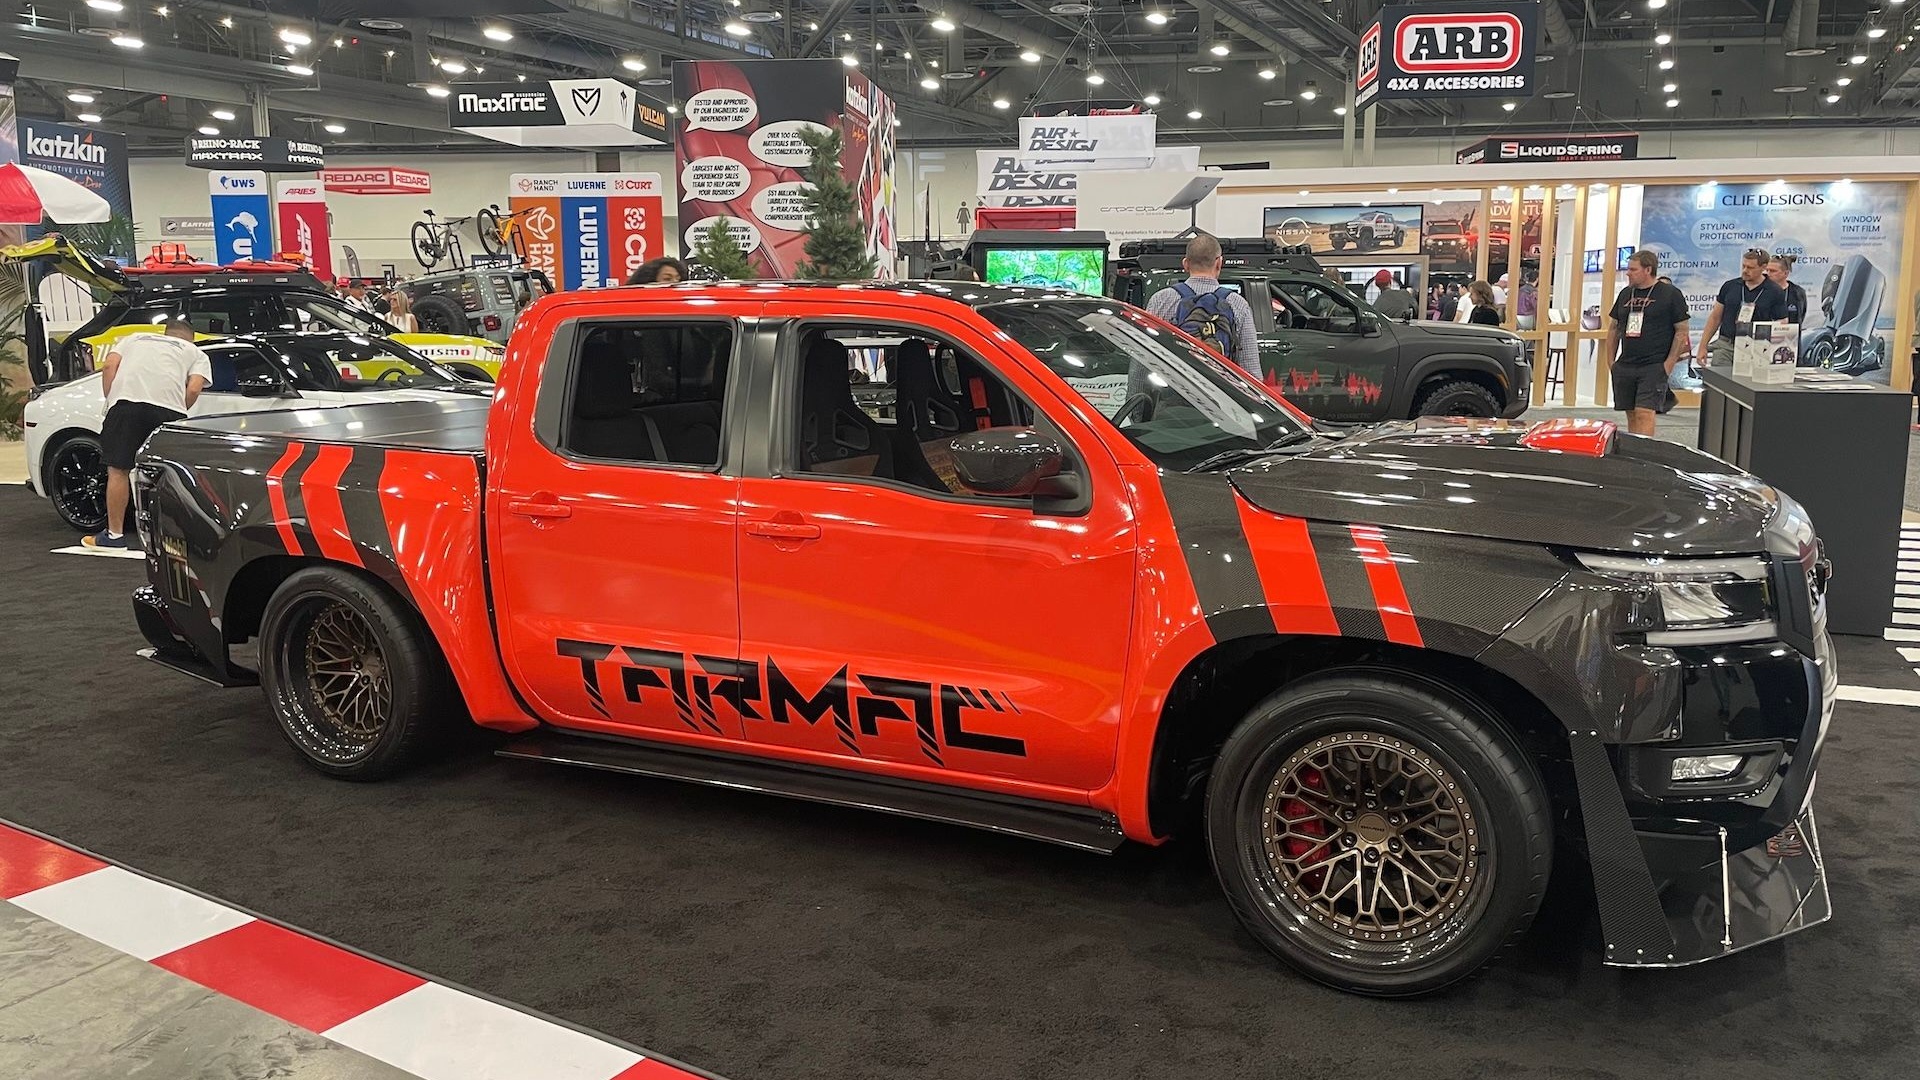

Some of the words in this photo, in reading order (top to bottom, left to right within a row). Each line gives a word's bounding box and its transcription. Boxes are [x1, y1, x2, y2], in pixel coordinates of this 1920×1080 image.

[1409, 26, 1508, 61] ARB
[1361, 35, 1378, 78] ARB
[1386, 78, 1420, 91] 4X4
[1423, 76, 1525, 90] ACCESSORIES
[458, 93, 548, 113] MaxTrac
[723, 98, 748, 106] APPROVED
[637, 103, 666, 127] VULCAN
[1031, 127, 1069, 139] AIR
[26, 127, 107, 164] katzkin
[197, 139, 262, 150] RHINO-RACK
[1028, 139, 1099, 152] DESIGN
[191, 152, 263, 161] MAXTRAX
[75, 167, 105, 178] LEATHER
[324, 173, 386, 183] REDARC
[231, 179, 255, 188] UWS
[395, 174, 429, 186] REDARC
[567, 181, 607, 190] LUVERNE
[625, 180, 653, 190] CURT
[988, 173, 1077, 191] DESIG
[285, 187, 317, 195] ARIES
[1002, 195, 1077, 208] DESIG
[1722, 194, 1755, 207] CLIF
[1758, 193, 1825, 206] DESIGNS
[1489, 204, 1560, 216] ADVNTUE
[1842, 215, 1881, 223] WINDOW
[1700, 223, 1736, 231] STYLING
[1699, 232, 1754, 240] PROTECTION
[1754, 232, 1774, 240] FILM
[578, 206, 600, 288] LUVERN
[1775, 247, 1803, 255] GLASS
[1657, 260, 1699, 269] OTECTION
[1700, 260, 1719, 268] FILM
[1797, 256, 1829, 264] ECTION
[1684, 294, 1717, 302] ADLIGHT
[419, 348, 471, 356] nismo
[162, 536, 188, 557] Mobil
[173, 561, 184, 599] 1
[555, 637, 1028, 768] TARMAC
